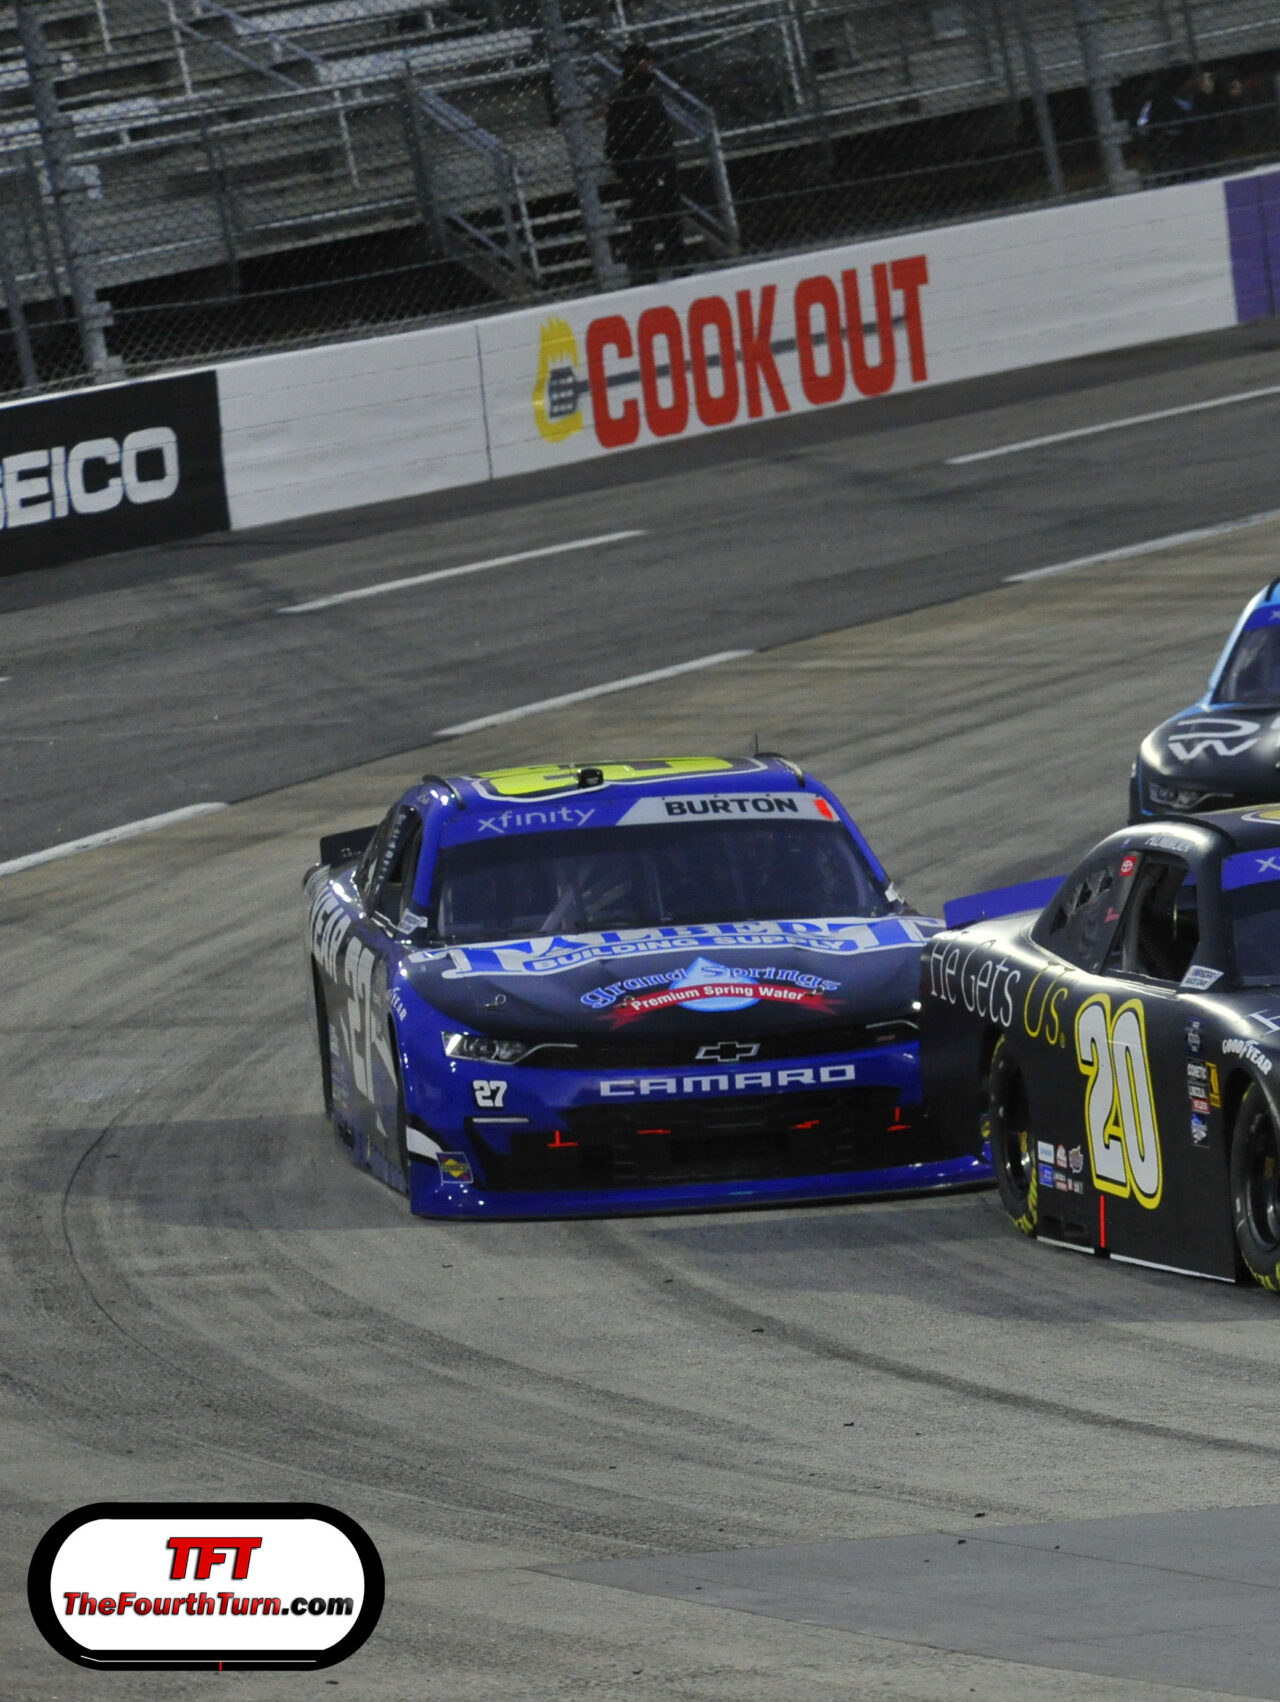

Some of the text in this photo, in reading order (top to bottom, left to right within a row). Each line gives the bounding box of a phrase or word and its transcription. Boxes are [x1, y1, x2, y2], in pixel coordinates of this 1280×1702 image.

[585, 254, 930, 449] COOK OUT
[0, 426, 180, 530] EICO
[476, 797, 799, 835] xfinity BURTON
[532, 935, 847, 971] BUILDING SUPPLY
[580, 963, 842, 1010] Grand Springs
[631, 984, 805, 1012] Premium Spring Water
[930, 931, 1069, 1049] He Gets Us.
[1221, 1038, 1274, 1076] GOODYEAR
[472, 1079, 508, 1108] 27
[600, 1064, 856, 1097] CAMARO
[1073, 992, 1163, 1210] 20
